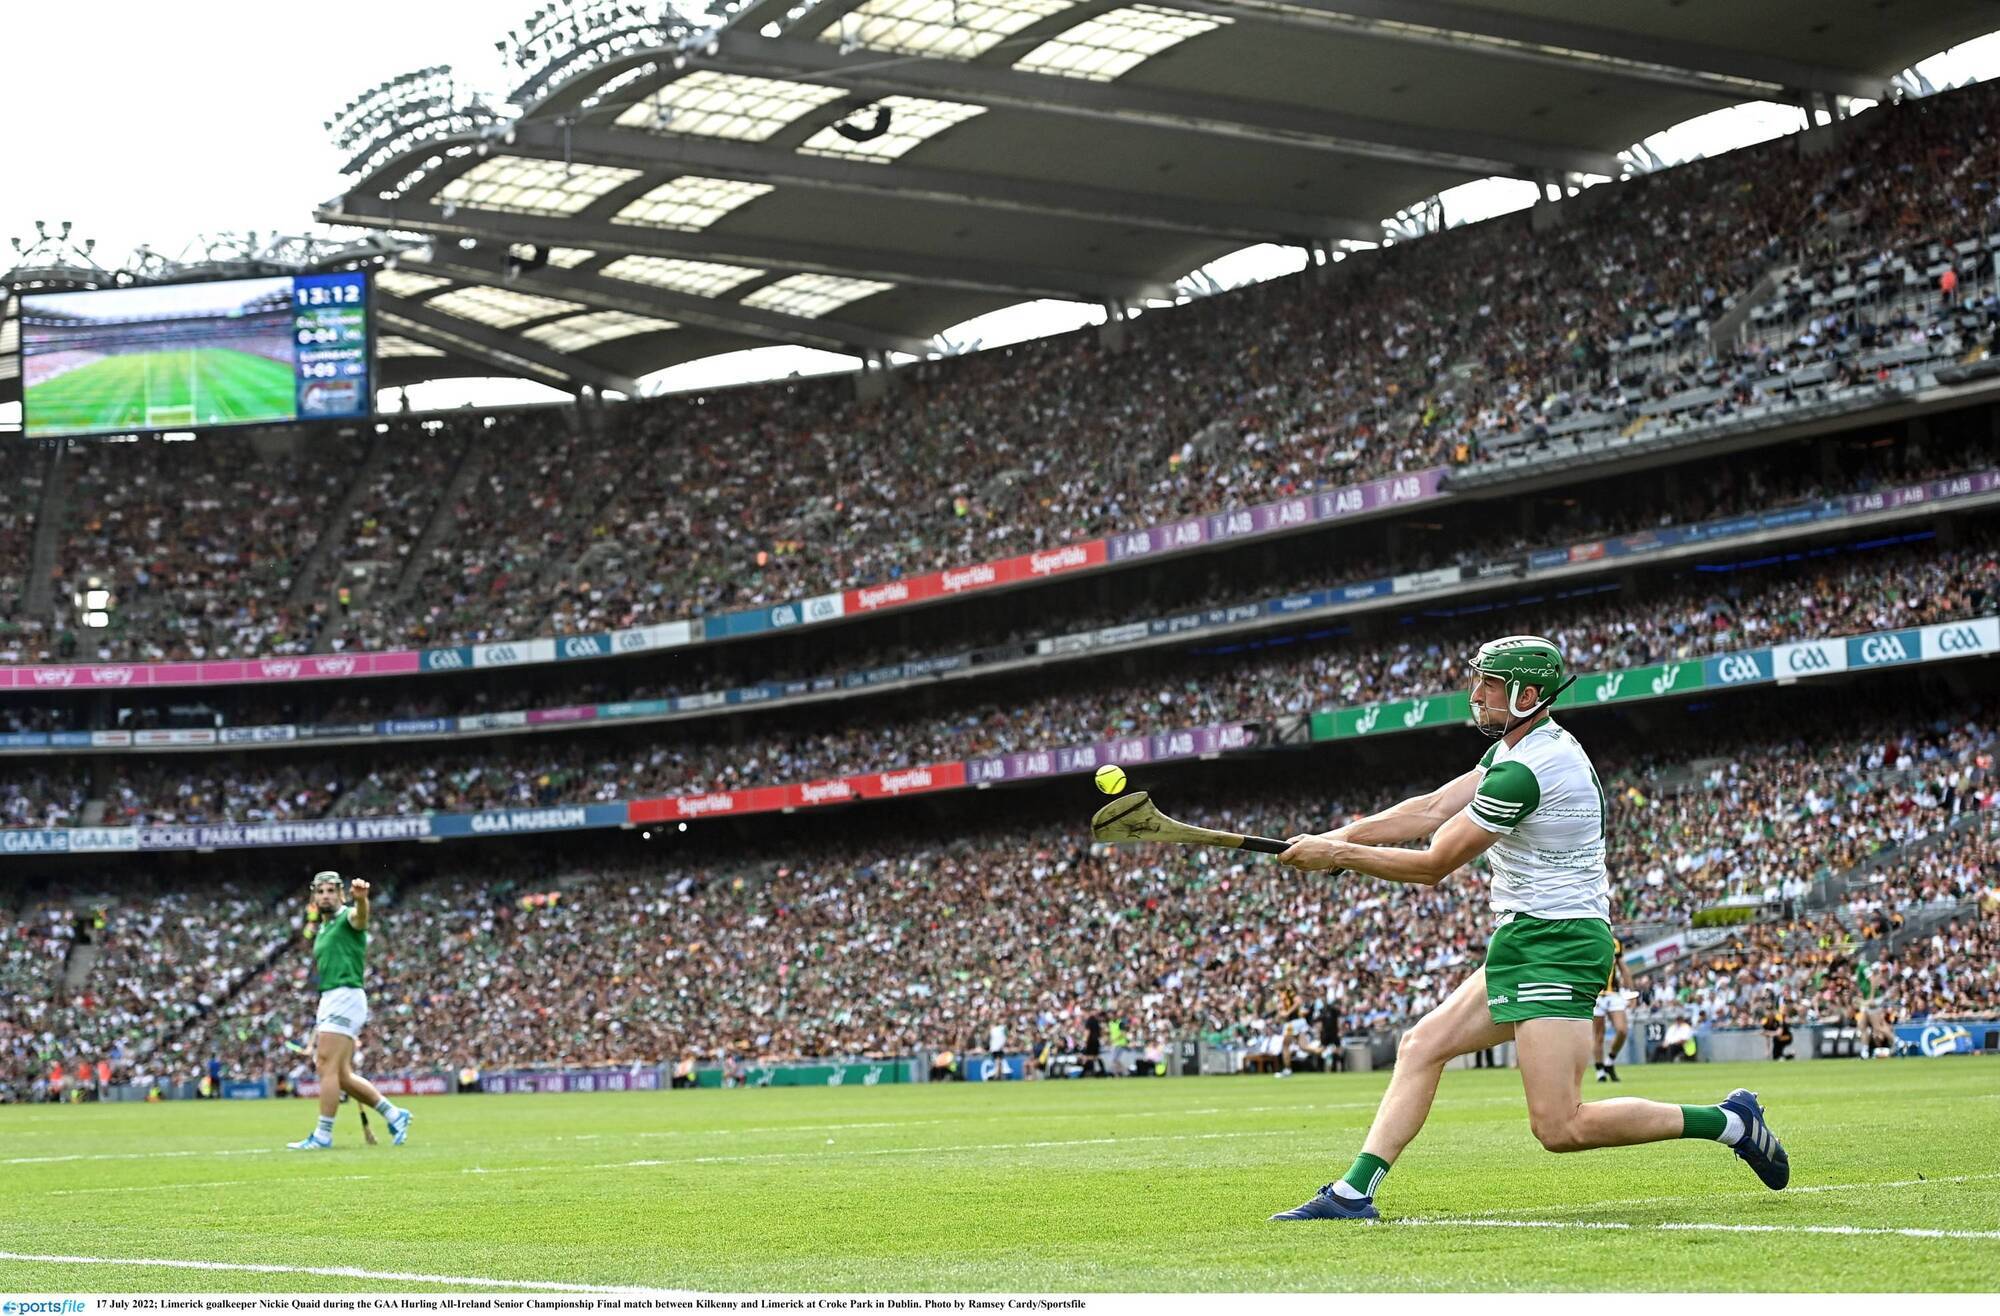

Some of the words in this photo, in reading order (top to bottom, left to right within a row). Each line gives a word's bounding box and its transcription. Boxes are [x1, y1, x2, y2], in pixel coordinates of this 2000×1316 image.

[1126, 532, 1150, 554] AIB
[1175, 522, 1200, 544] AIB
[1227, 511, 1253, 534] AIB
[1280, 501, 1306, 524] AIB
[1336, 489, 1363, 512] AIB
[1393, 477, 1421, 500] AIB
[859, 582, 908, 609] SuperValu
[942, 565, 995, 592] SuperValu
[1031, 547, 1087, 575] SuperValu
[33, 668, 76, 687] very
[91, 667, 134, 685] very
[261, 659, 300, 678] very
[316, 656, 355, 675] very
[1718, 652, 1761, 683] GAA
[1789, 645, 1831, 672] GAA
[1861, 634, 1907, 665] GAA
[1938, 624, 1982, 654] GAA
[1356, 702, 1380, 734] eir
[1404, 698, 1429, 727] eir
[1596, 672, 1623, 701] eir
[1652, 663, 1680, 694] eir
[981, 760, 1005, 779] AIB
[1026, 753, 1049, 772] AIB
[1072, 747, 1096, 768] AIB
[1119, 740, 1144, 761] AIB
[1169, 733, 1194, 754] AIB
[1218, 726, 1244, 746] AIB
[677, 794, 733, 818] SuperValu
[801, 780, 850, 805] SuperValu
[880, 769, 932, 795] SuperValu
[138, 829, 196, 848] CROKE
[201, 826, 243, 846] PARK
[244, 821, 339, 843] MEETINGS
[341, 821, 355, 838] &
[357, 818, 431, 837] EVENTS
[471, 813, 509, 832] GAA
[513, 808, 586, 829] MUSEUM
